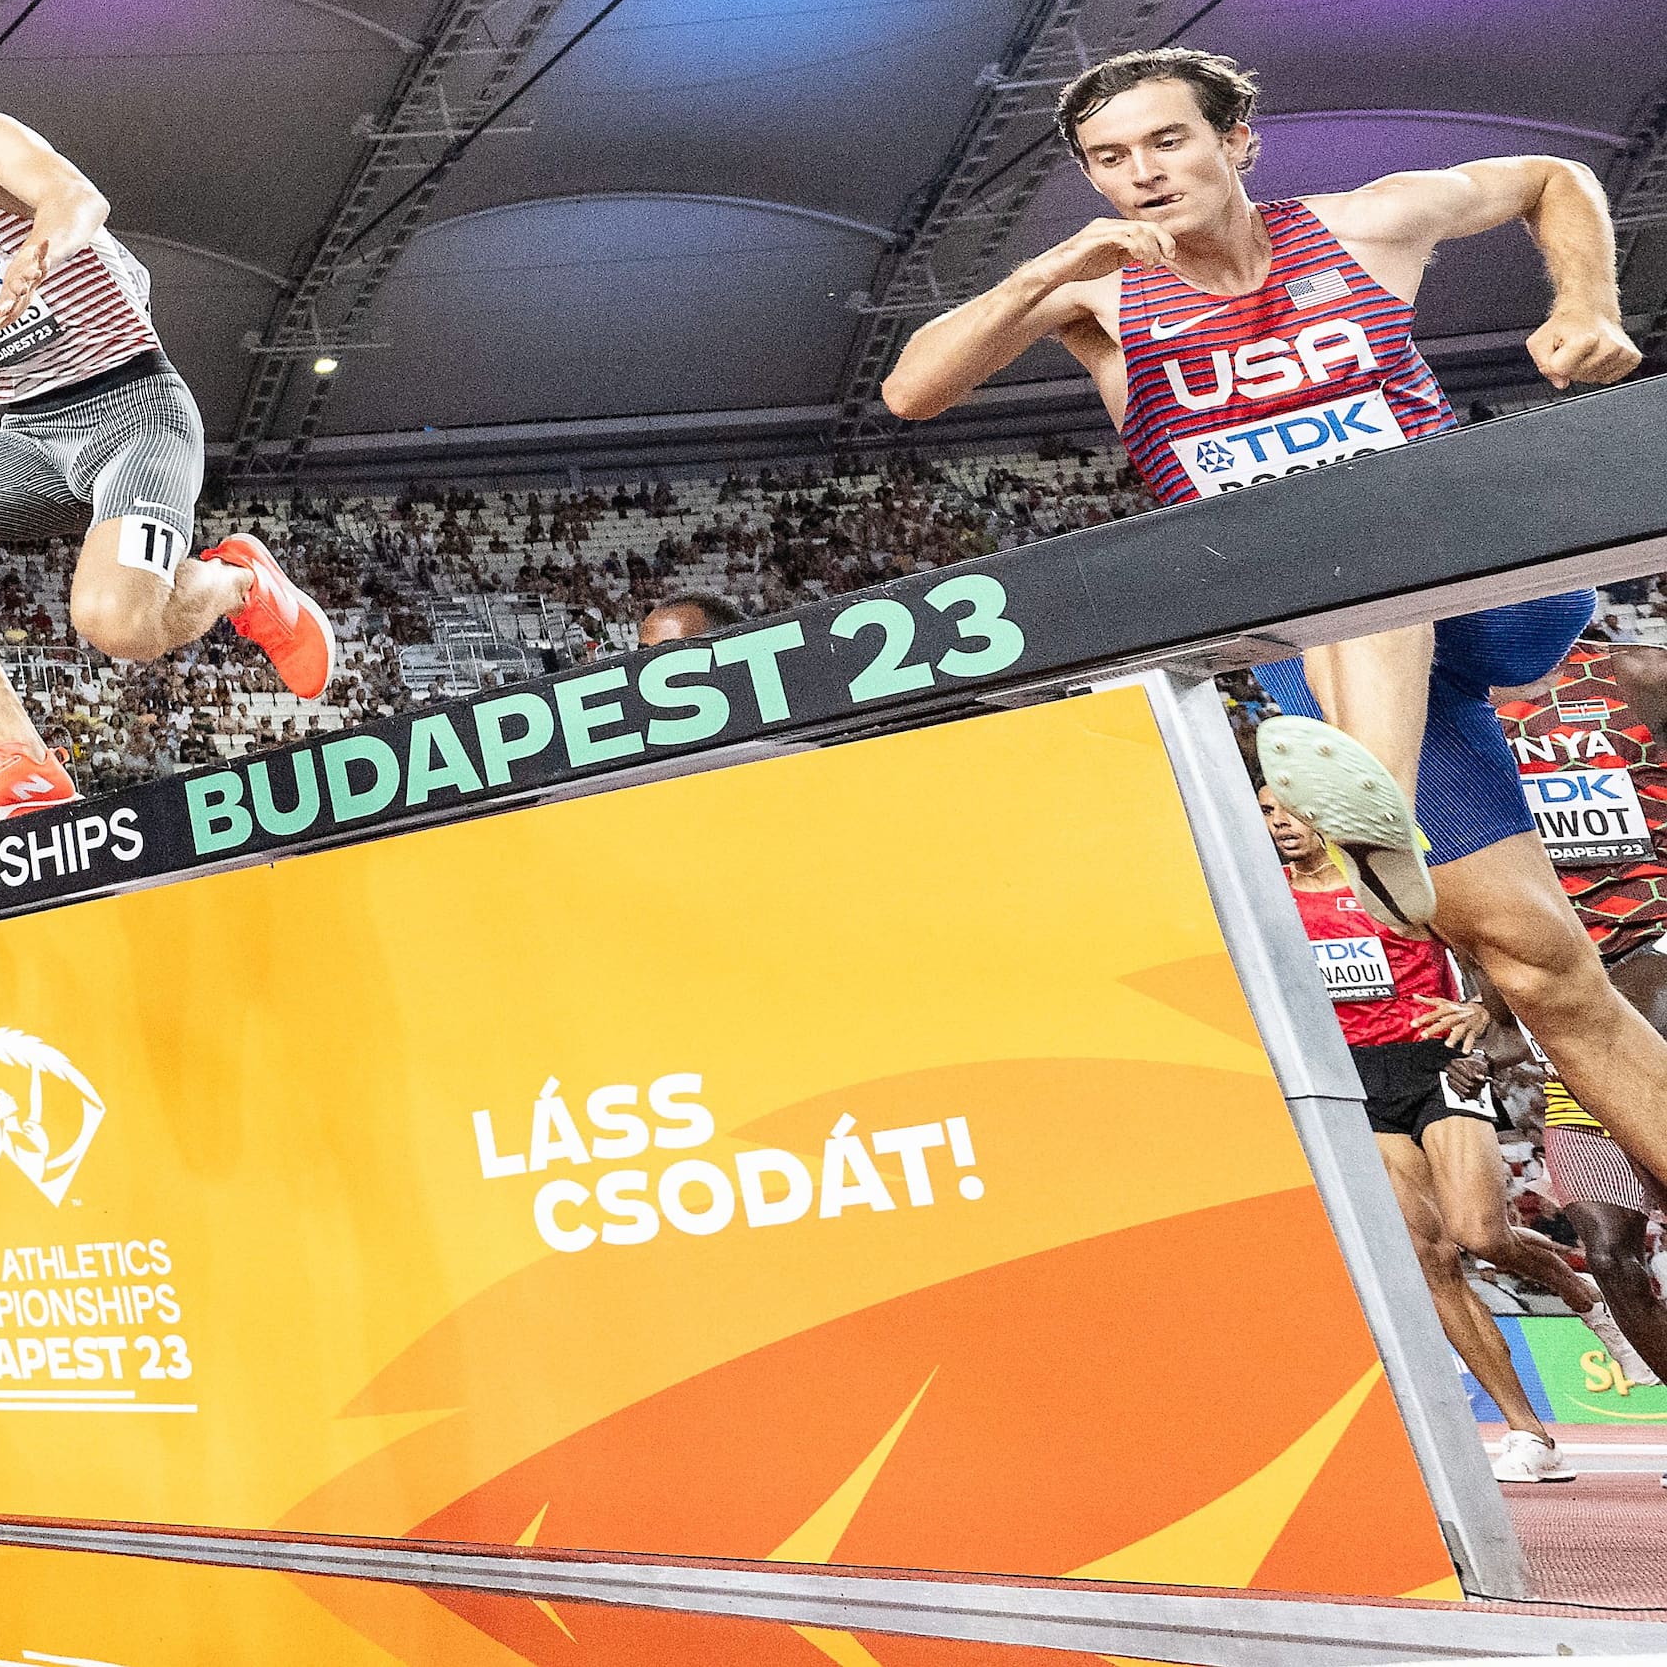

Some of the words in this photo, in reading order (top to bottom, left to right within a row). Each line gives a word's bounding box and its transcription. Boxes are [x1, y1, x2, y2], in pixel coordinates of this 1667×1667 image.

[36, 324, 53, 344] 23
[1162, 318, 1380, 411] USA
[1226, 401, 1383, 464] TDK
[141, 523, 174, 571] 11
[184, 619, 804, 856] BUDAPEST
[828, 573, 1027, 704] 23
[1507, 730, 1617, 764] NYA
[1546, 846, 1619, 859] DAPEST
[1620, 843, 1644, 856] 23
[472, 1073, 715, 1180] LÁSS
[533, 1111, 985, 1253] CSODÁT!
[1, 1238, 172, 1282] ATHLETICS
[134, 1335, 193, 1380] 23
